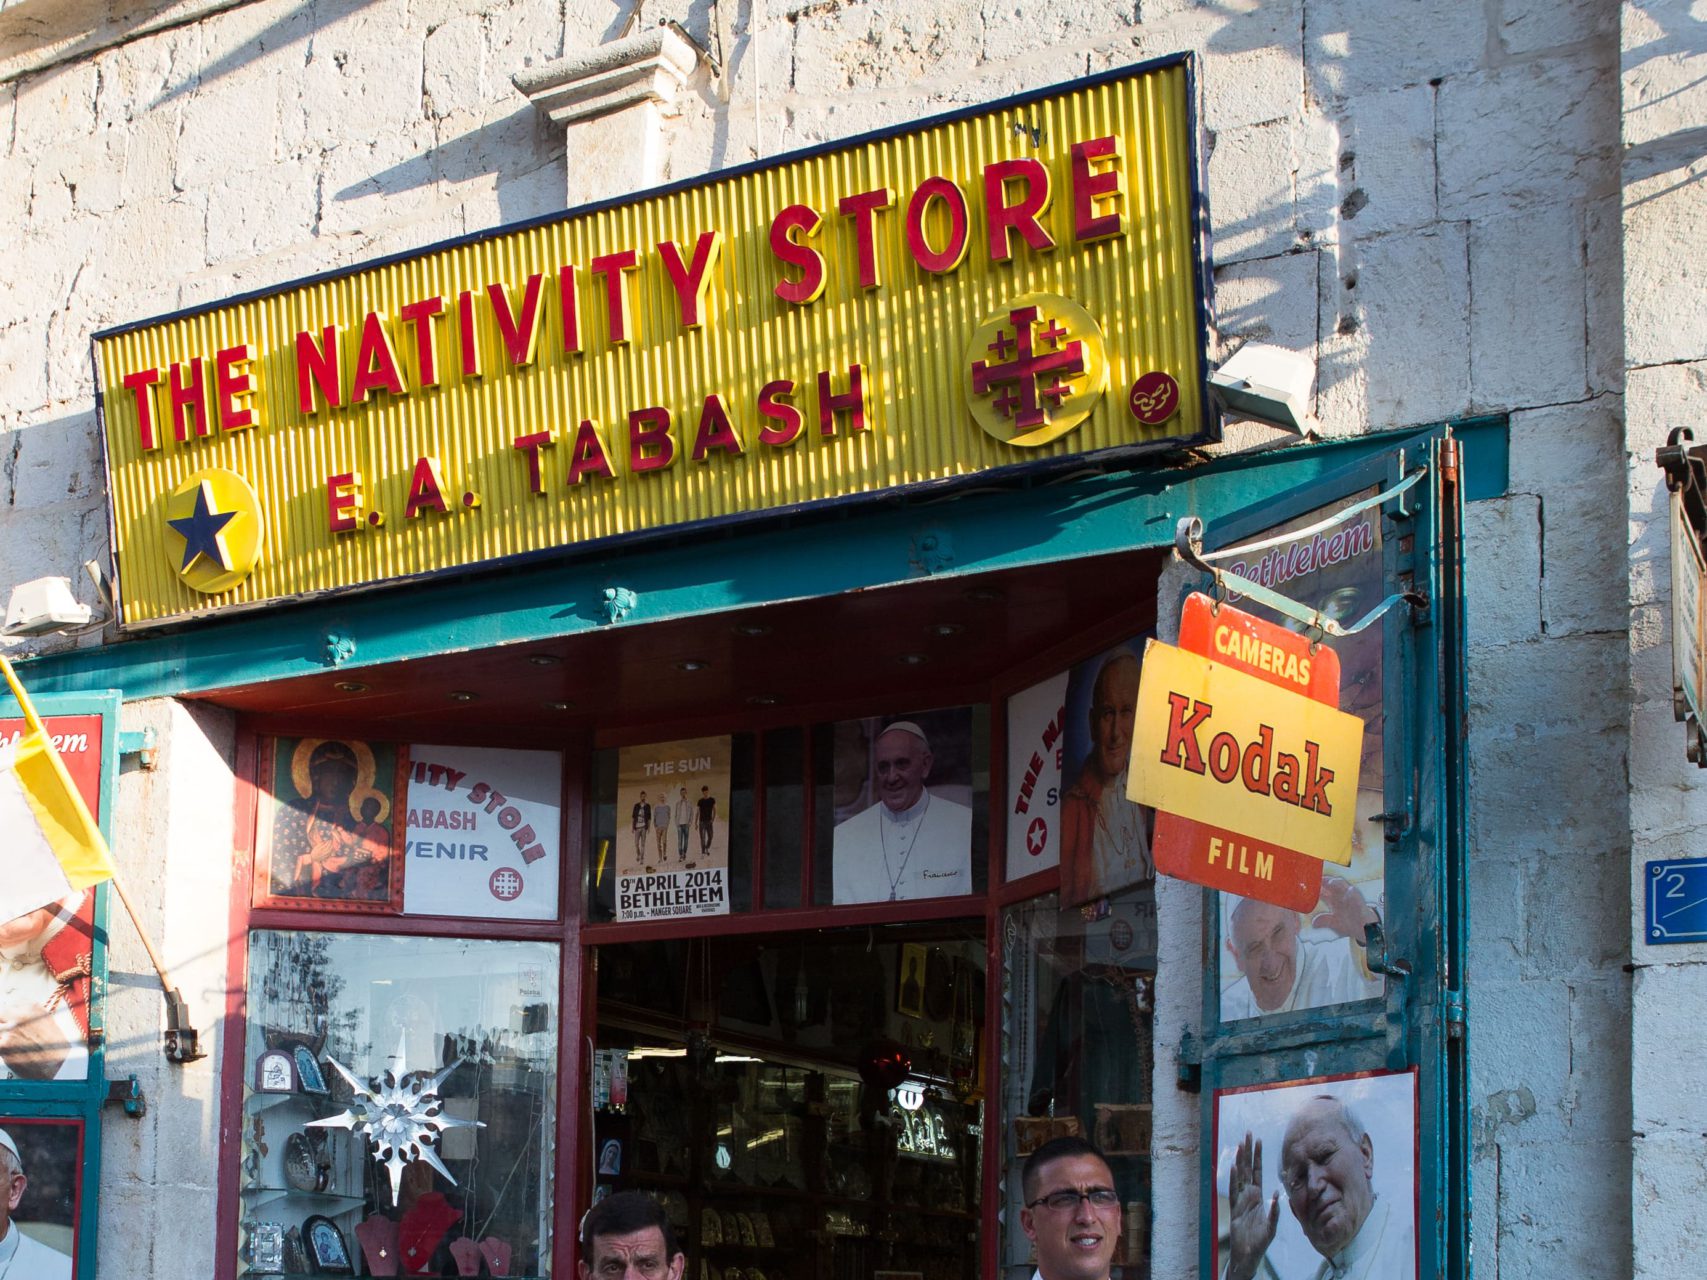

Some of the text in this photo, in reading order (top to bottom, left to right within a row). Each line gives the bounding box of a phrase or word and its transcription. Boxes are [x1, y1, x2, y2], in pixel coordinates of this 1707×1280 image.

[124, 134, 1127, 450] THE NATIVITY STORE
[327, 363, 871, 533] E. A. TABASH
[1214, 624, 1311, 686] CAMERAS
[643, 757, 711, 777] THE SUN
[1160, 691, 1335, 817] Kodak
[1014, 751, 1045, 815] THE
[466, 782, 547, 865] STORE
[635, 874, 681, 892] APRIL
[685, 870, 723, 888] 2014
[1207, 837, 1275, 881] FILM
[1665, 873, 1686, 898] 2
[620, 886, 724, 909] BETHLEHEM
[650, 907, 672, 917] MANGER
[672, 905, 692, 915] SQUARE
